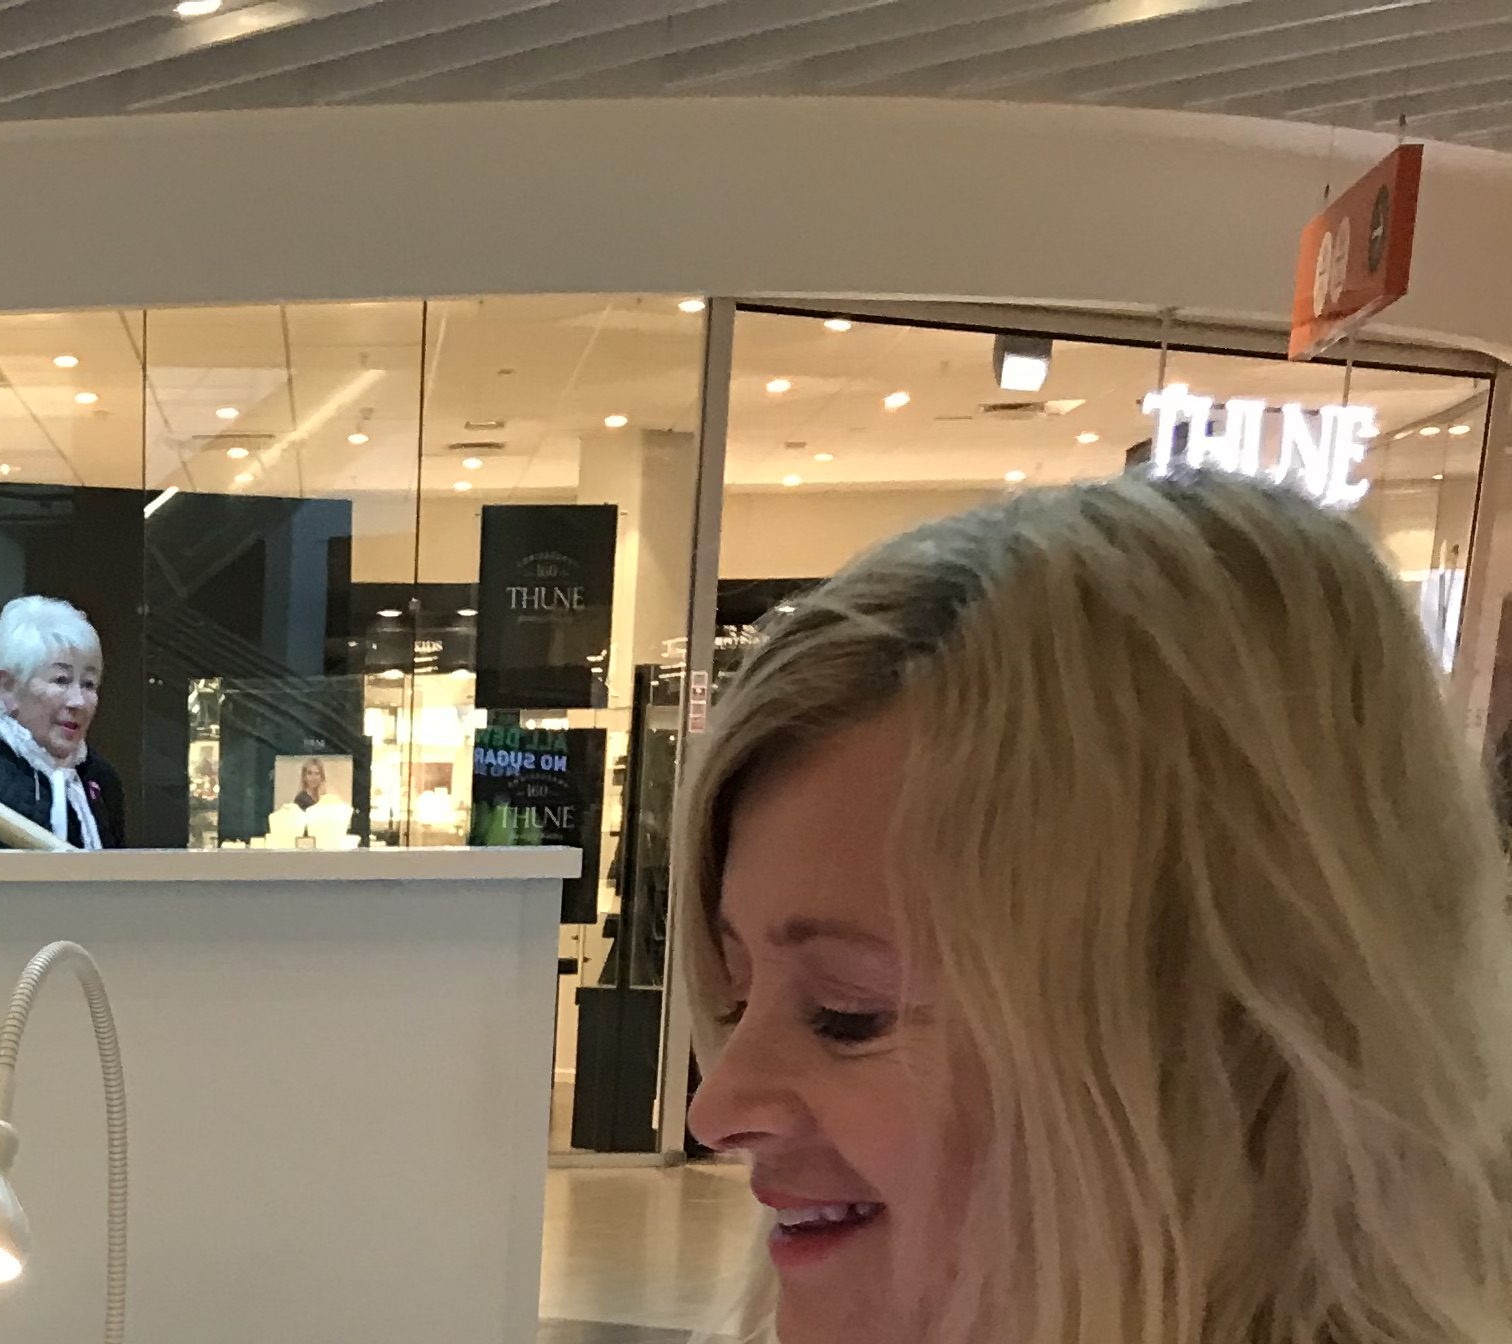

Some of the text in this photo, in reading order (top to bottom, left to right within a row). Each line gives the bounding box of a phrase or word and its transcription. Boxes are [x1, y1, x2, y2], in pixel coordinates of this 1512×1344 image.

[1142, 383, 1381, 510] THUNE
[505, 586, 586, 610] THUNE
[496, 804, 576, 829] THUNE
